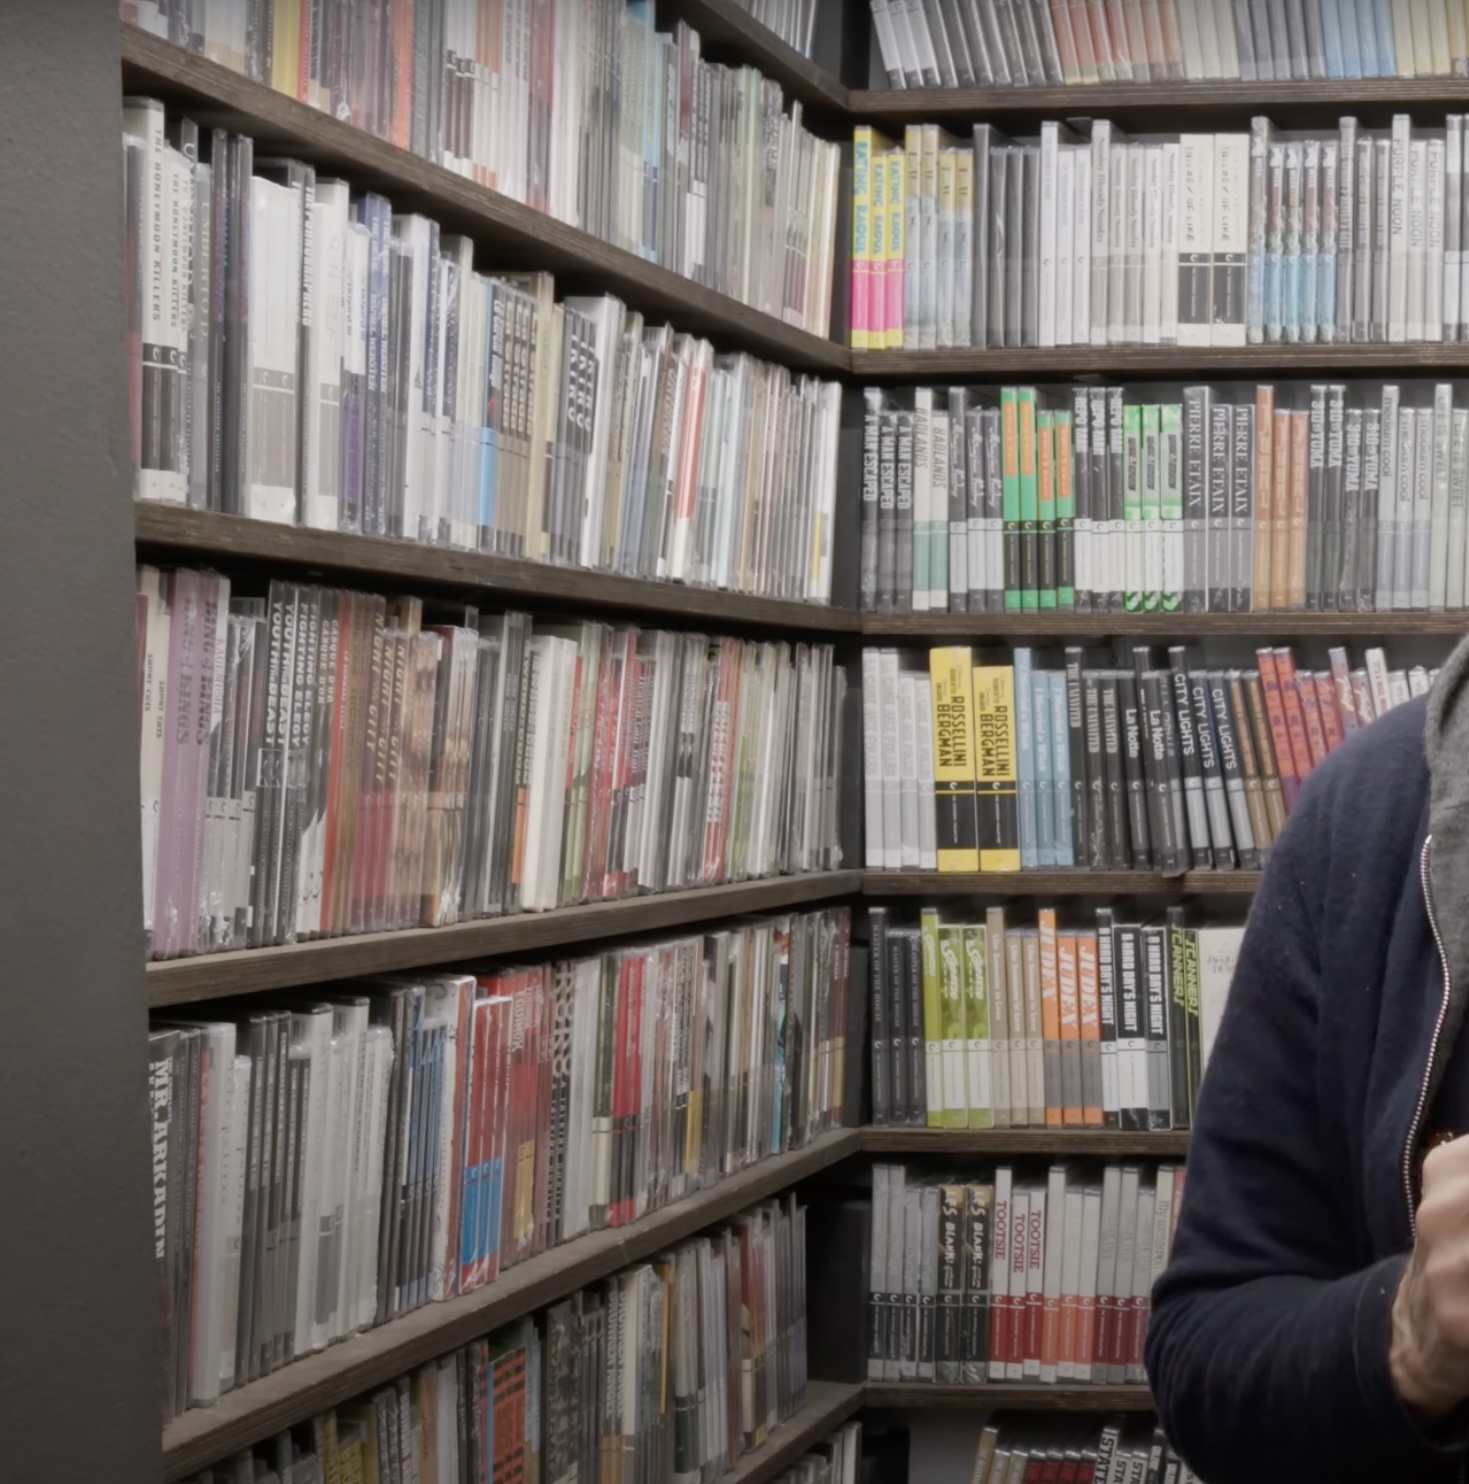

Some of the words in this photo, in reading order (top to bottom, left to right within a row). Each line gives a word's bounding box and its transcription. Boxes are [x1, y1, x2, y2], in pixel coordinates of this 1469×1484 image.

[154, 128, 164, 154] THE
[171, 173, 180, 193] THE
[855, 141, 868, 195] EATING
[873, 163, 883, 207] EATING
[891, 161, 901, 204] EATING
[1185, 146, 1195, 194] TRILOGY
[1221, 146, 1230, 194] TRILOGY
[1392, 139, 1404, 193] PURPLE
[153, 162, 163, 253] HONEYMOON
[1186, 197, 1195, 212] OF
[1221, 197, 1230, 212] OF
[1391, 199, 1403, 235] NOON
[171, 200, 179, 275] HONEYMOON
[855, 205, 868, 254] RAOUL
[873, 215, 883, 254] RAOUL
[892, 212, 902, 251] RAOUL
[1186, 216, 1195, 242] LIFE
[1221, 216, 1231, 242] LIFE
[1410, 211, 1423, 247] NOON
[1429, 211, 1441, 248] NOON
[151, 260, 161, 321] KILLERS
[170, 279, 178, 328] KILLERS
[864, 426, 878, 450] MAN
[1189, 400, 1202, 455] PIERRE
[1235, 408, 1249, 463] PIERRE
[1382, 397, 1393, 448] medium
[880, 437, 894, 460] MAN
[898, 437, 912, 460] MAN
[1310, 432, 1325, 469] YUMA
[1328, 432, 1343, 468] YUMA
[1381, 450, 1393, 478] cool
[863, 453, 879, 501] ESCAPED
[880, 463, 895, 510] ESCAPED
[897, 463, 912, 510] ESCAPED
[1345, 456, 1361, 492] YUMA
[1364, 455, 1379, 491] YUMA
[1400, 475, 1411, 502] cool
[1418, 473, 1430, 500] cool
[1451, 468, 1465, 508] SWEET
[203, 599, 218, 653] KING
[270, 601, 283, 664] YOUTH
[281, 602, 295, 665] YOUTH
[295, 603, 309, 686] FIGHTING
[305, 603, 319, 687] FIGHTING
[319, 619, 331, 670] CASQUE
[328, 619, 340, 670] CASQUE
[372, 612, 385, 674] NIGHT
[212, 640, 225, 715] KAGEMUSHA
[381, 645, 394, 706] NIGHT
[394, 644, 406, 706] NIGHT
[1067, 662, 1080, 681] THE
[1174, 672, 1189, 706] CITY
[158, 681, 166, 711] SHORT
[176, 673, 193, 745] KINGS
[196, 674, 213, 746] KINGS
[265, 683, 280, 748] BEAST
[276, 684, 292, 748] BEAST
[1068, 682, 1082, 728] UNINVITED
[1085, 688, 1099, 706] THE
[1102, 689, 1116, 706] THE
[1125, 708, 1138, 725] La
[1149, 709, 1162, 726] La
[1192, 687, 1208, 719] CITY
[1212, 688, 1228, 720] CITY
[156, 715, 164, 739] CUTS
[291, 690, 303, 749] ELEGY
[301, 690, 313, 749] ELEGY
[366, 704, 379, 752] CITY
[936, 703, 953, 767] BERGMAN
[950, 695, 967, 767] ROSSELLINI
[993, 704, 1010, 777] ROSSELLINI
[1087, 707, 1100, 753] UNINVITED
[1104, 707, 1118, 753] UNINVITED
[1127, 726, 1140, 759] Notte
[1178, 709, 1195, 757] LIGHTS
[375, 736, 388, 783] CITY
[388, 736, 400, 782] CITY
[979, 712, 996, 777] BERGMAN
[1151, 727, 1165, 761] Notte
[1197, 722, 1215, 769] LIGHTS
[1217, 724, 1237, 769] LIGHTS
[1039, 920, 1057, 999] JUDEX
[1098, 936, 1112, 963] HARD
[1120, 933, 1134, 941] A
[1121, 942, 1136, 970] HARD
[1147, 936, 1161, 944] A
[1147, 945, 1162, 972] HARD
[1060, 946, 1078, 1029] JUDEX
[1080, 946, 1098, 1029] JUDEX
[1171, 922, 1185, 1007] SCANNERS
[1186, 938, 1199, 1017] SCANNERS
[512, 988, 526, 1053] EQUINOX
[1101, 994, 1114, 1025] NIGHT
[1123, 1000, 1138, 1032] NIGHT
[1149, 1003, 1164, 1036] NIGHT
[943, 1187, 959, 1216] LES
[971, 1187, 987, 1216] LES
[995, 1200, 1007, 1260] TOOTSIE
[1013, 1214, 1026, 1274] TOOTSIE
[1029, 1210, 1042, 1270] TOOTSIE
